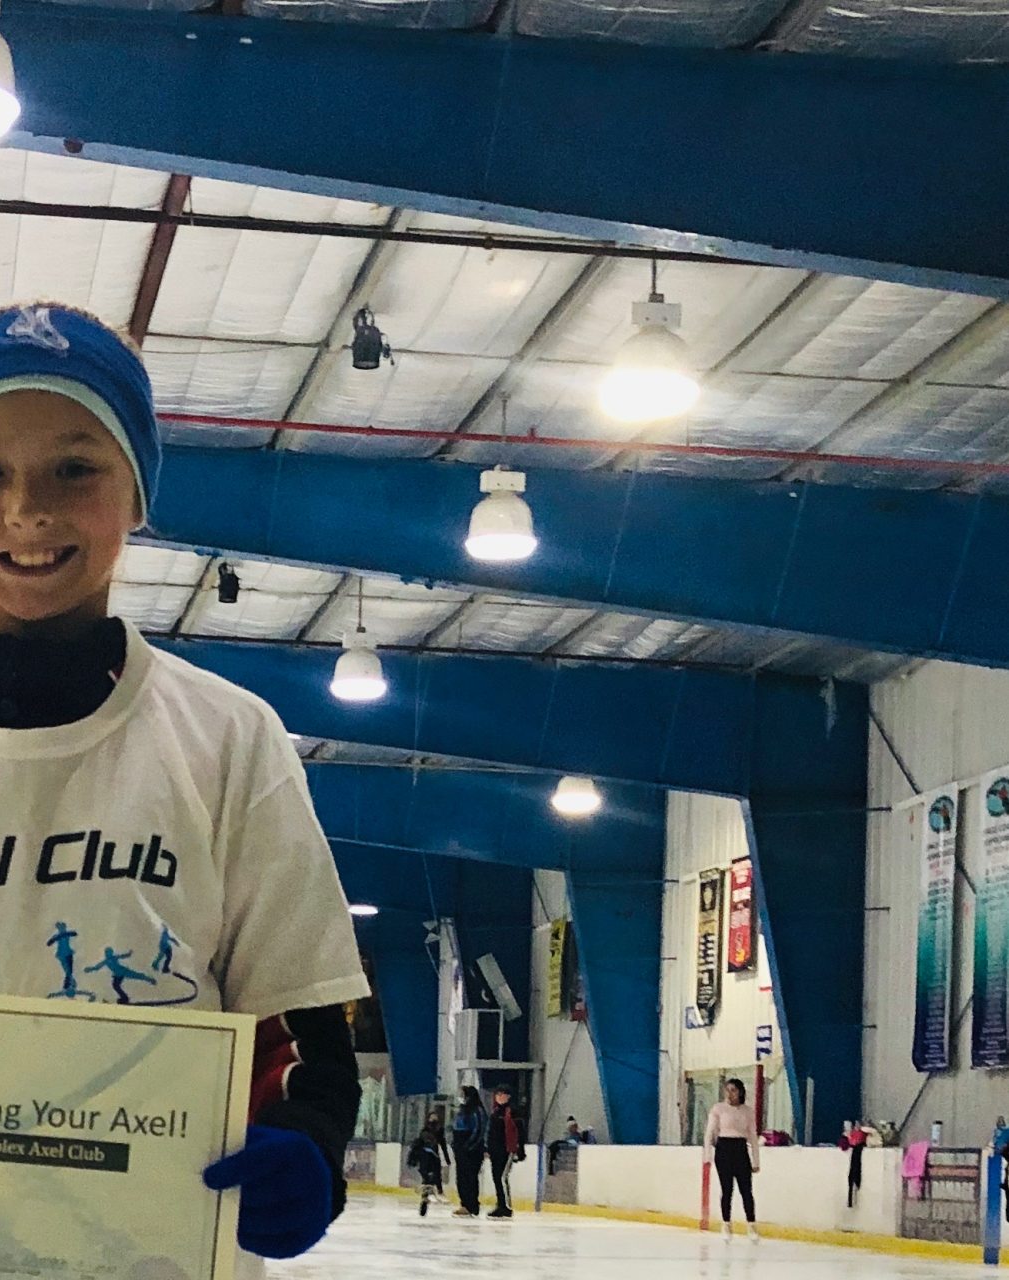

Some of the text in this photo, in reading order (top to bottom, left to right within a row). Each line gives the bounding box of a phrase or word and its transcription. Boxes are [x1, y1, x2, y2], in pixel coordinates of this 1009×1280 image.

[36, 830, 178, 888] Club
[31, 1099, 102, 1131] Your
[110, 1107, 189, 1138] Axel!
[29, 1141, 64, 1160] Axel
[67, 1144, 106, 1162] Club
